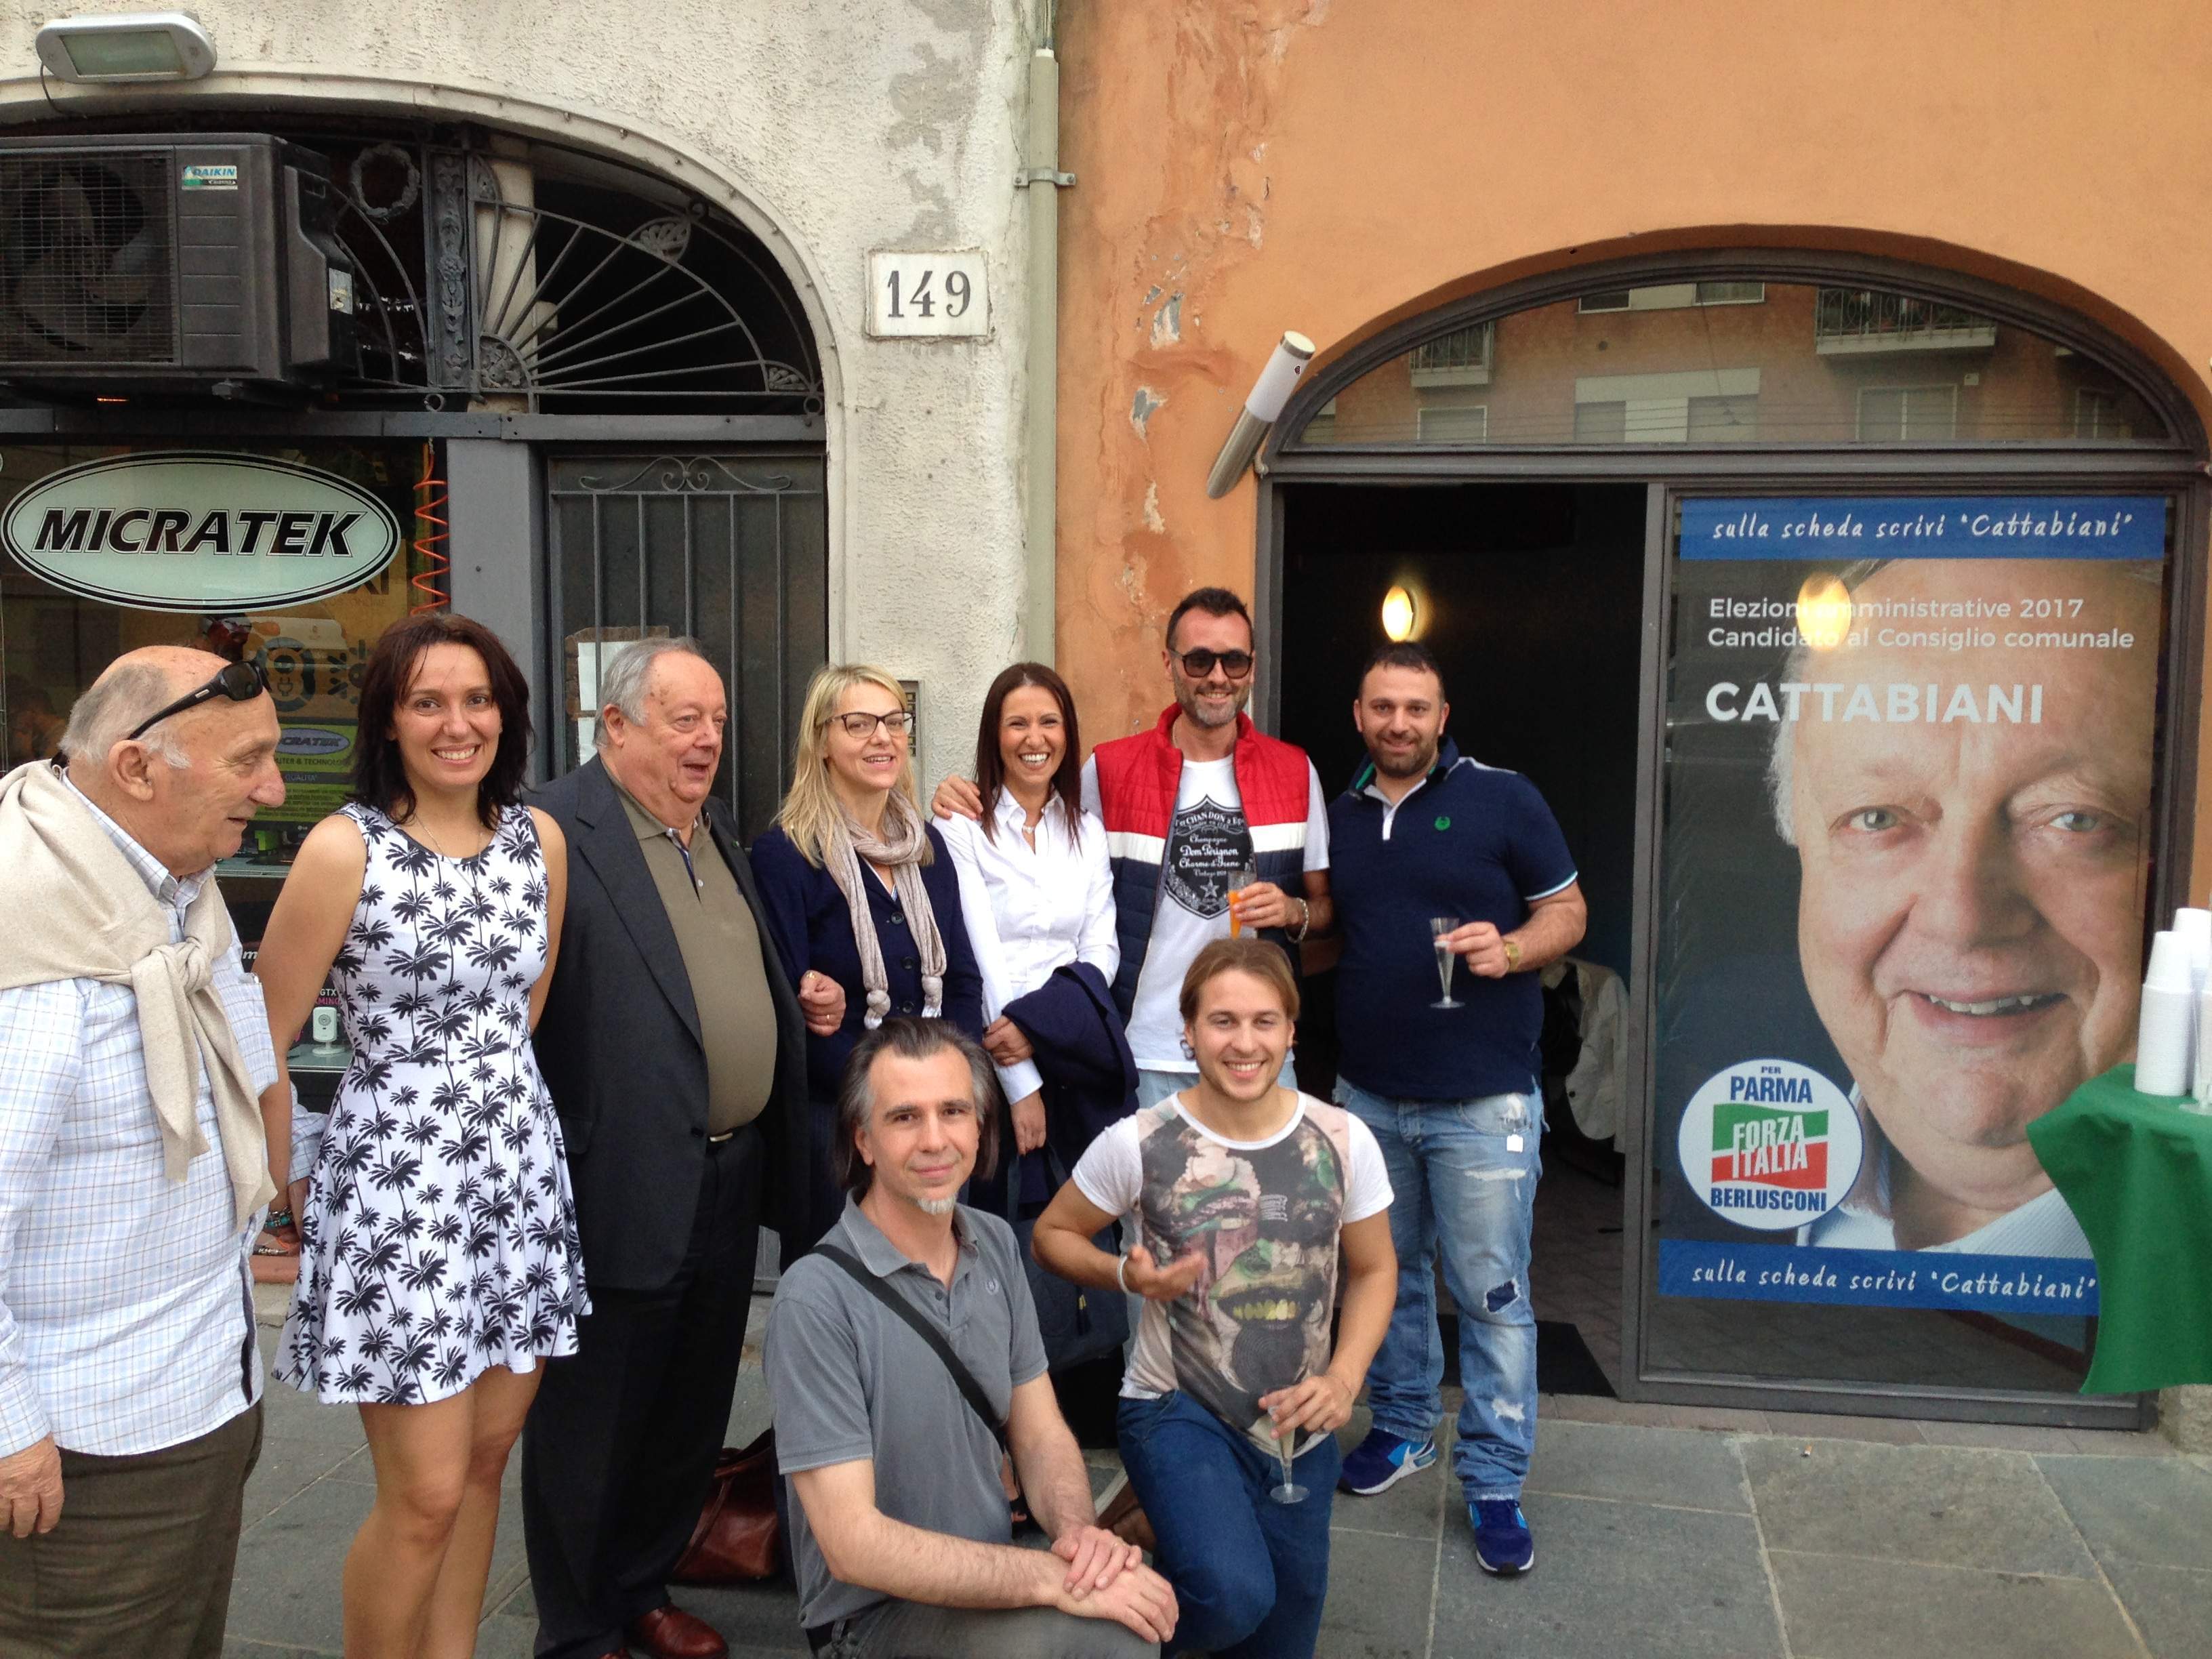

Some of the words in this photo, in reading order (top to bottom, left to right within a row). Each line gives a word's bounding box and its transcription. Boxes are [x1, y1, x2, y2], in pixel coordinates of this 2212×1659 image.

[192, 168, 235, 176] DAIKIN
[887, 270, 971, 318] 149
[31, 507, 367, 558] MICRATEK
[1713, 512, 1769, 539] sulla
[1781, 512, 1863, 539] scheda
[1875, 514, 1946, 538] scrivi
[1814, 597, 2012, 619] mministrative
[2019, 598, 2084, 619] 2017
[1707, 627, 1841, 647] Candidato
[1848, 628, 1869, 647] al
[1877, 627, 1996, 651] Consiglio
[2004, 628, 2135, 648] comunale
[1705, 682, 2043, 724] CATTABIANI
[1186, 811, 1225, 825] CHANDON
[1180, 845, 1202, 856] Dom
[316, 997, 341, 1005] MING
[320, 988, 337, 996] GTX
[1761, 1066, 1781, 1074] PER
[1730, 1076, 1814, 1103] PARMA
[1732, 1114, 1805, 1153] FORZA
[1732, 1139, 1808, 1179] ITALIA
[1711, 1187, 1827, 1212] BERLUSCONI
[1692, 1258, 1746, 1282] sulla
[1759, 1262, 1837, 1287] scheda
[1849, 1269, 1917, 1291] scrivi
